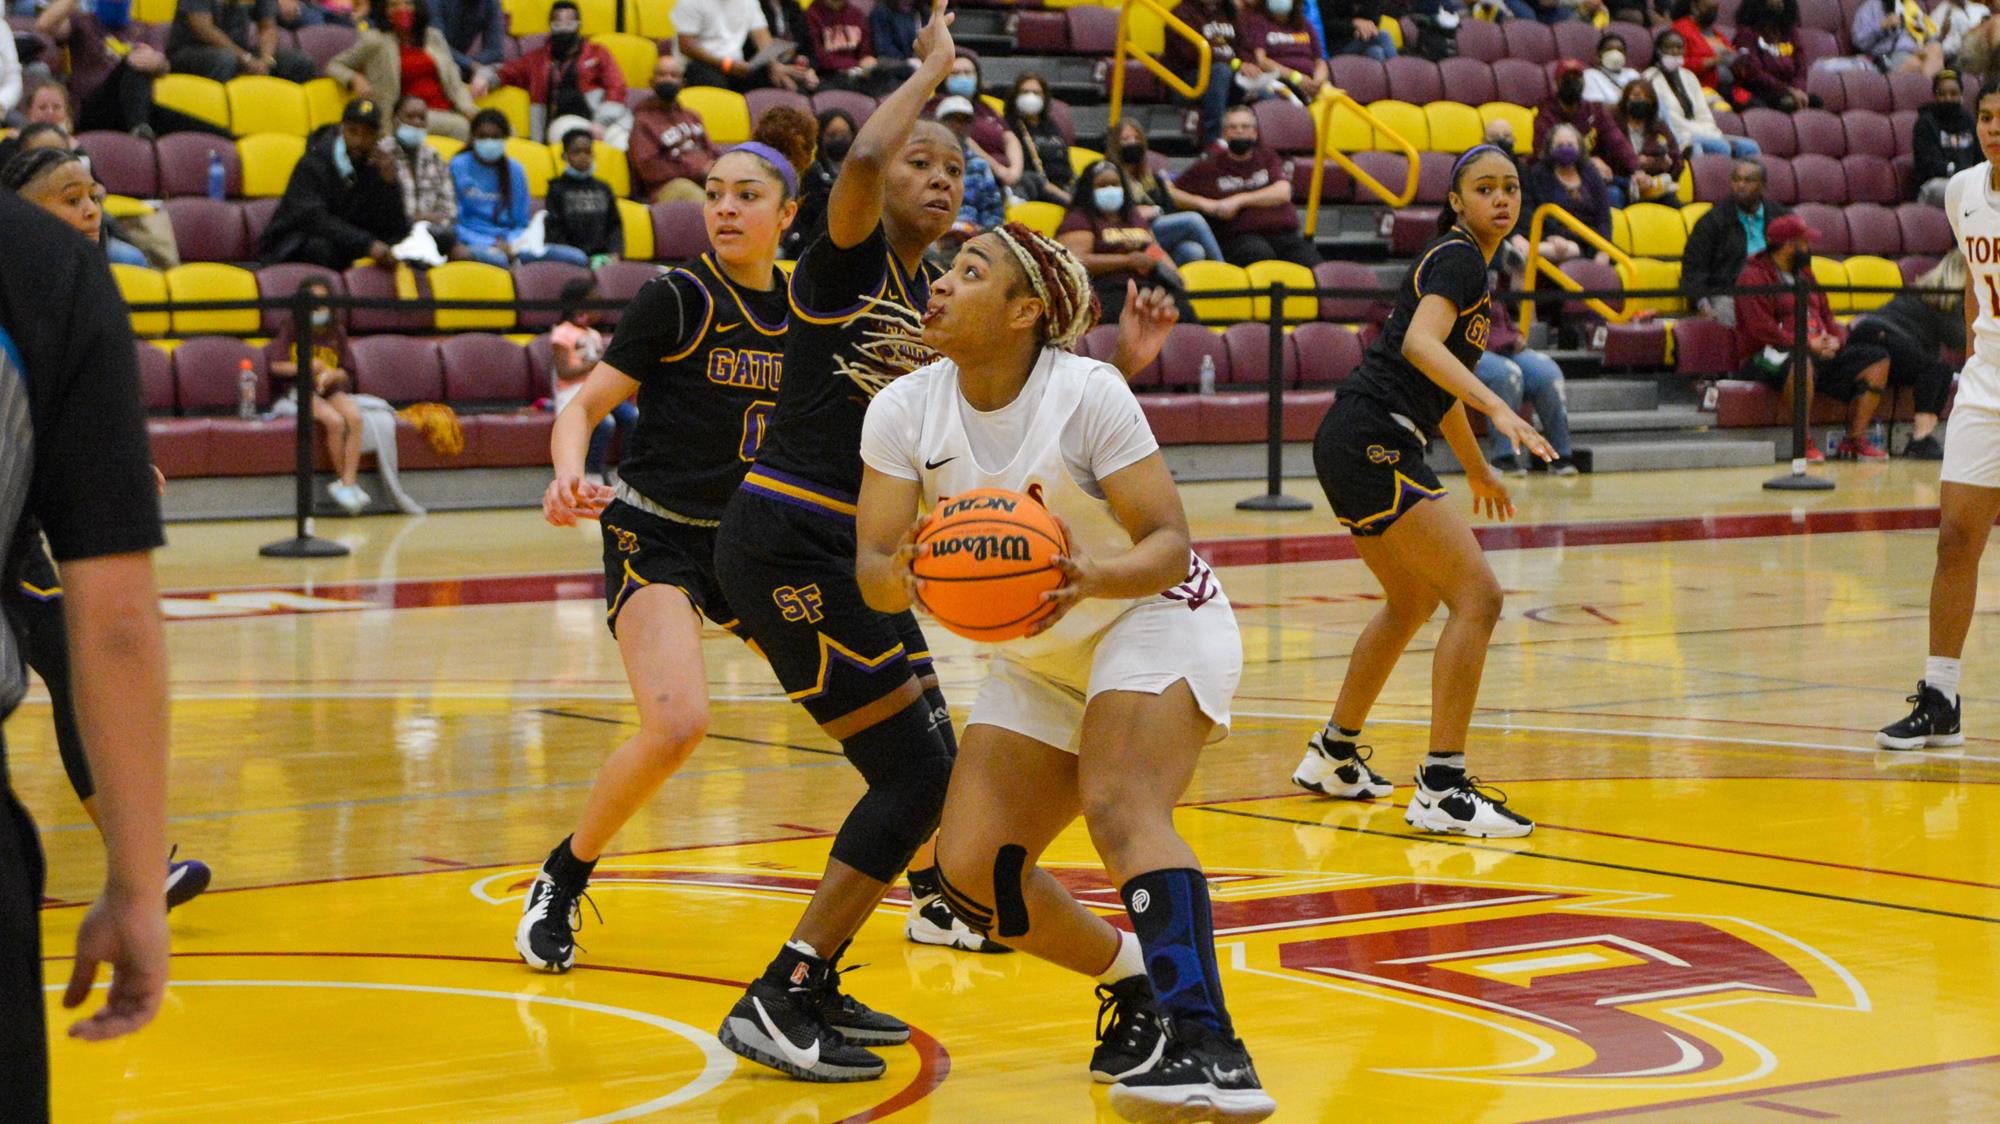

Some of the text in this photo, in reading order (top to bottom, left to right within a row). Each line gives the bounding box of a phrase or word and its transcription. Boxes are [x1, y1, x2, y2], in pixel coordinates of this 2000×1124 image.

[707, 347, 784, 391] GATO
[943, 495, 1018, 519] NCAA
[932, 534, 1032, 561] Wilson
[772, 583, 825, 624] SF
